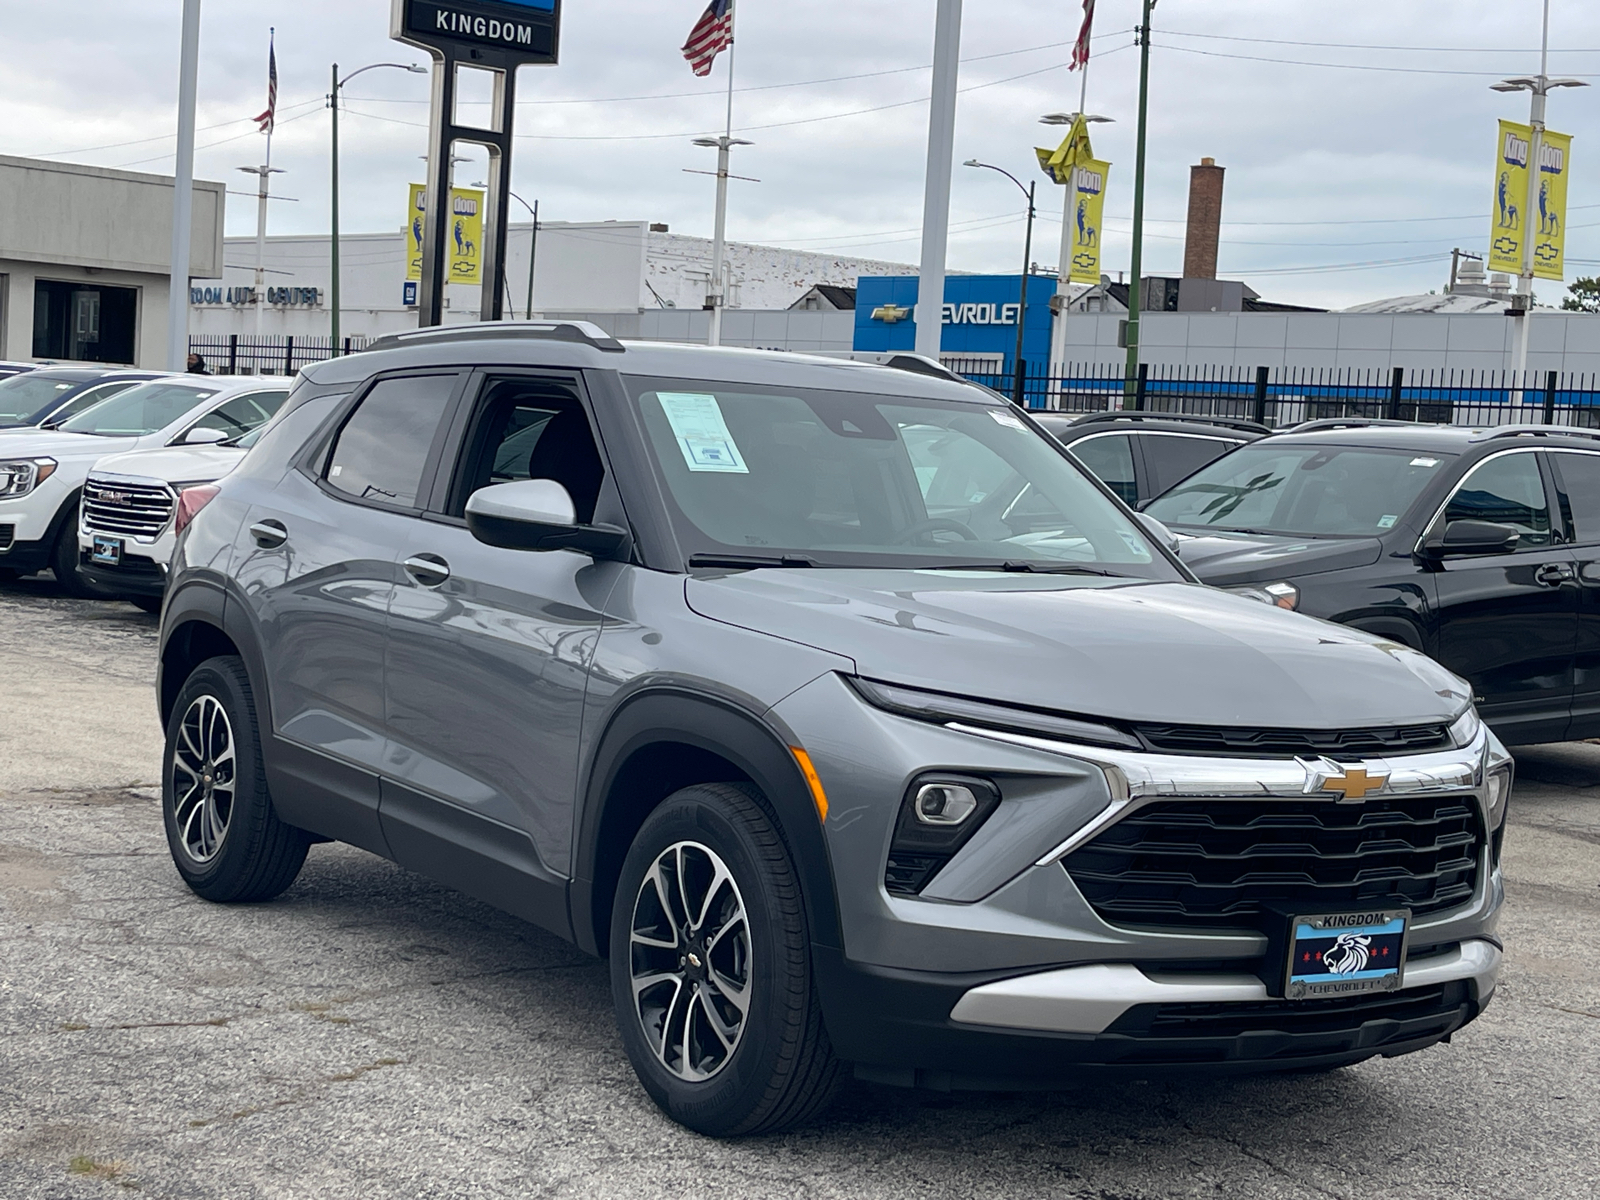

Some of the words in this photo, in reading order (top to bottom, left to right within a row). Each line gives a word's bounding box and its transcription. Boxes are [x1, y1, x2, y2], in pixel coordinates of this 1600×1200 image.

[436, 9, 532, 45] KINGDOM
[1503, 132, 1529, 168] King
[1540, 142, 1563, 173] dom
[1078, 167, 1102, 194] dom
[453, 195, 478, 216] dom
[267, 286, 319, 305] CENTER
[913, 303, 1028, 325] EVROLET
[98, 490, 132, 506] GMC
[1322, 913, 1385, 928] KINGDOM
[1313, 980, 1376, 995] CHEVROLET
